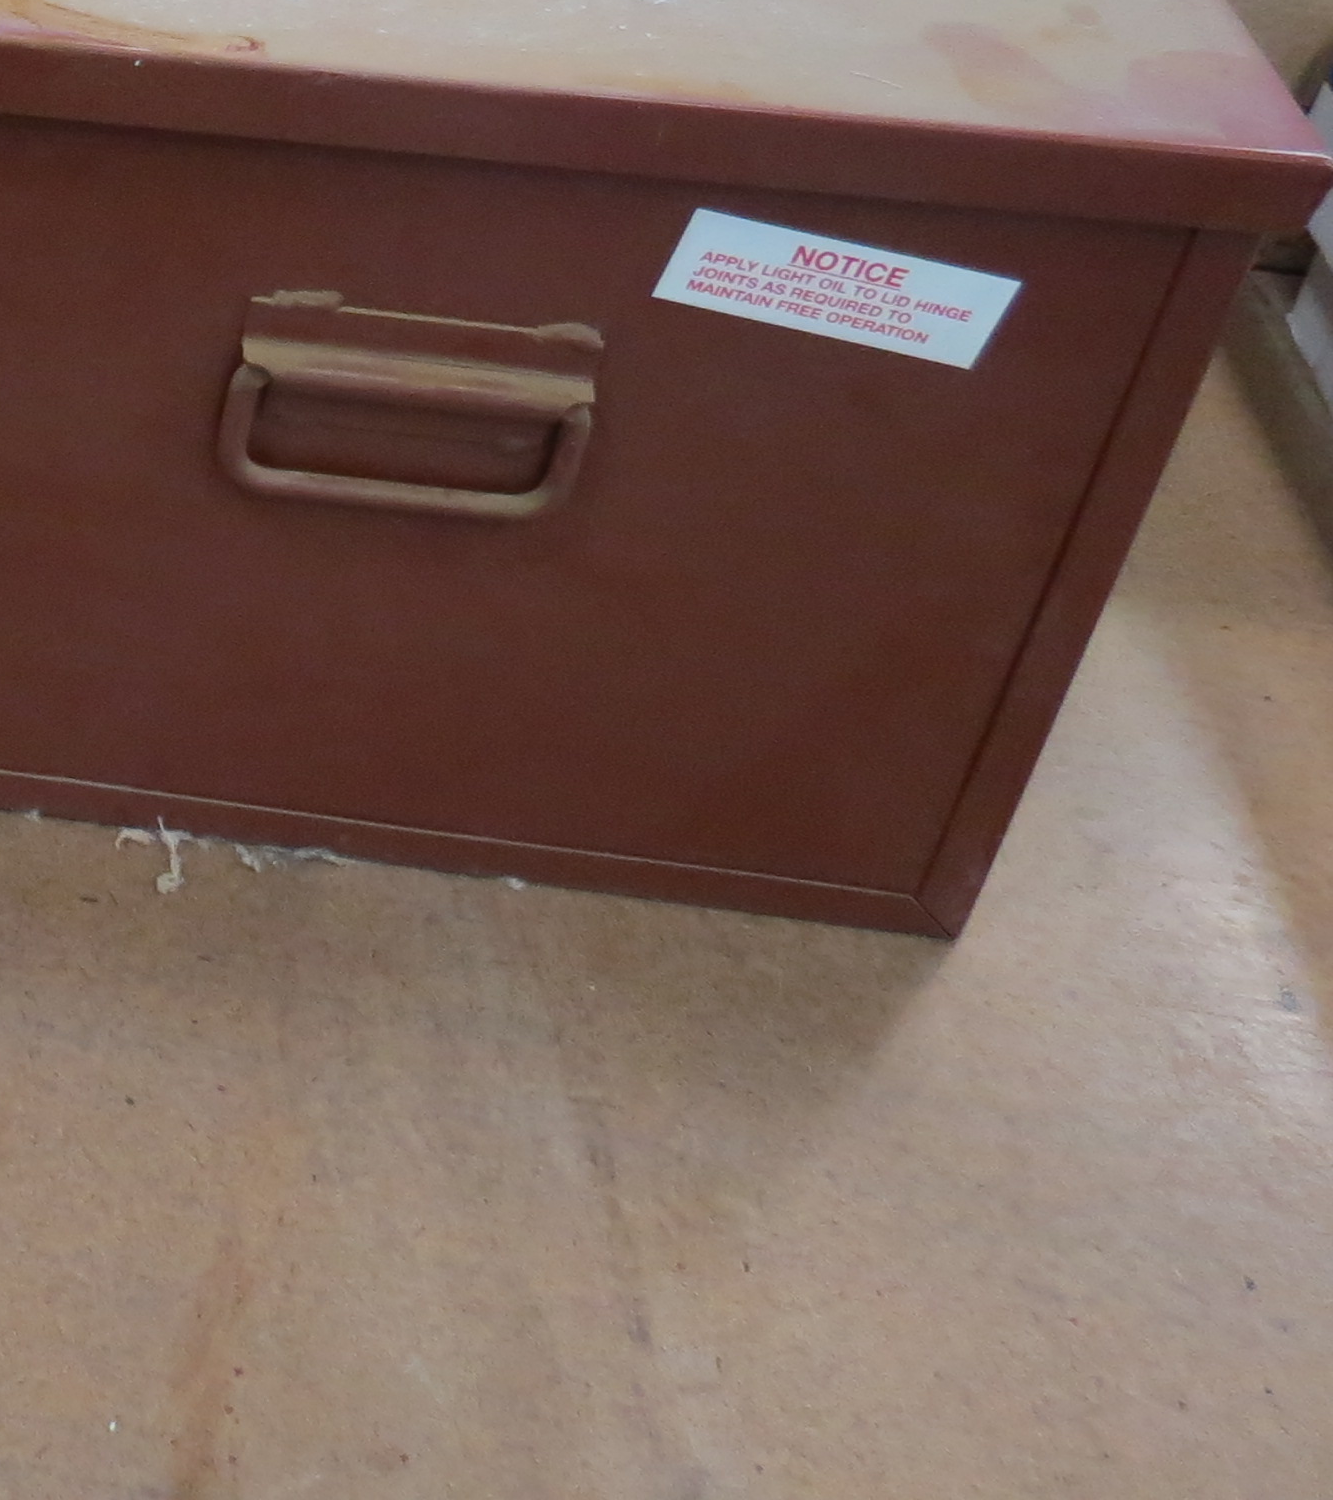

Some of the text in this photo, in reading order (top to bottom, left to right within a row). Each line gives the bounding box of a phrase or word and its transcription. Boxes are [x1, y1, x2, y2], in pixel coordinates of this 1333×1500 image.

[693, 266, 912, 324] JOINTS AS REQUIRED TO
[699, 251, 973, 322] APPLY LIGHT OIL TO LID HINGE
[790, 245, 910, 288] NOTICE
[686, 279, 930, 345] MAINTAIN FREE OPERATION
